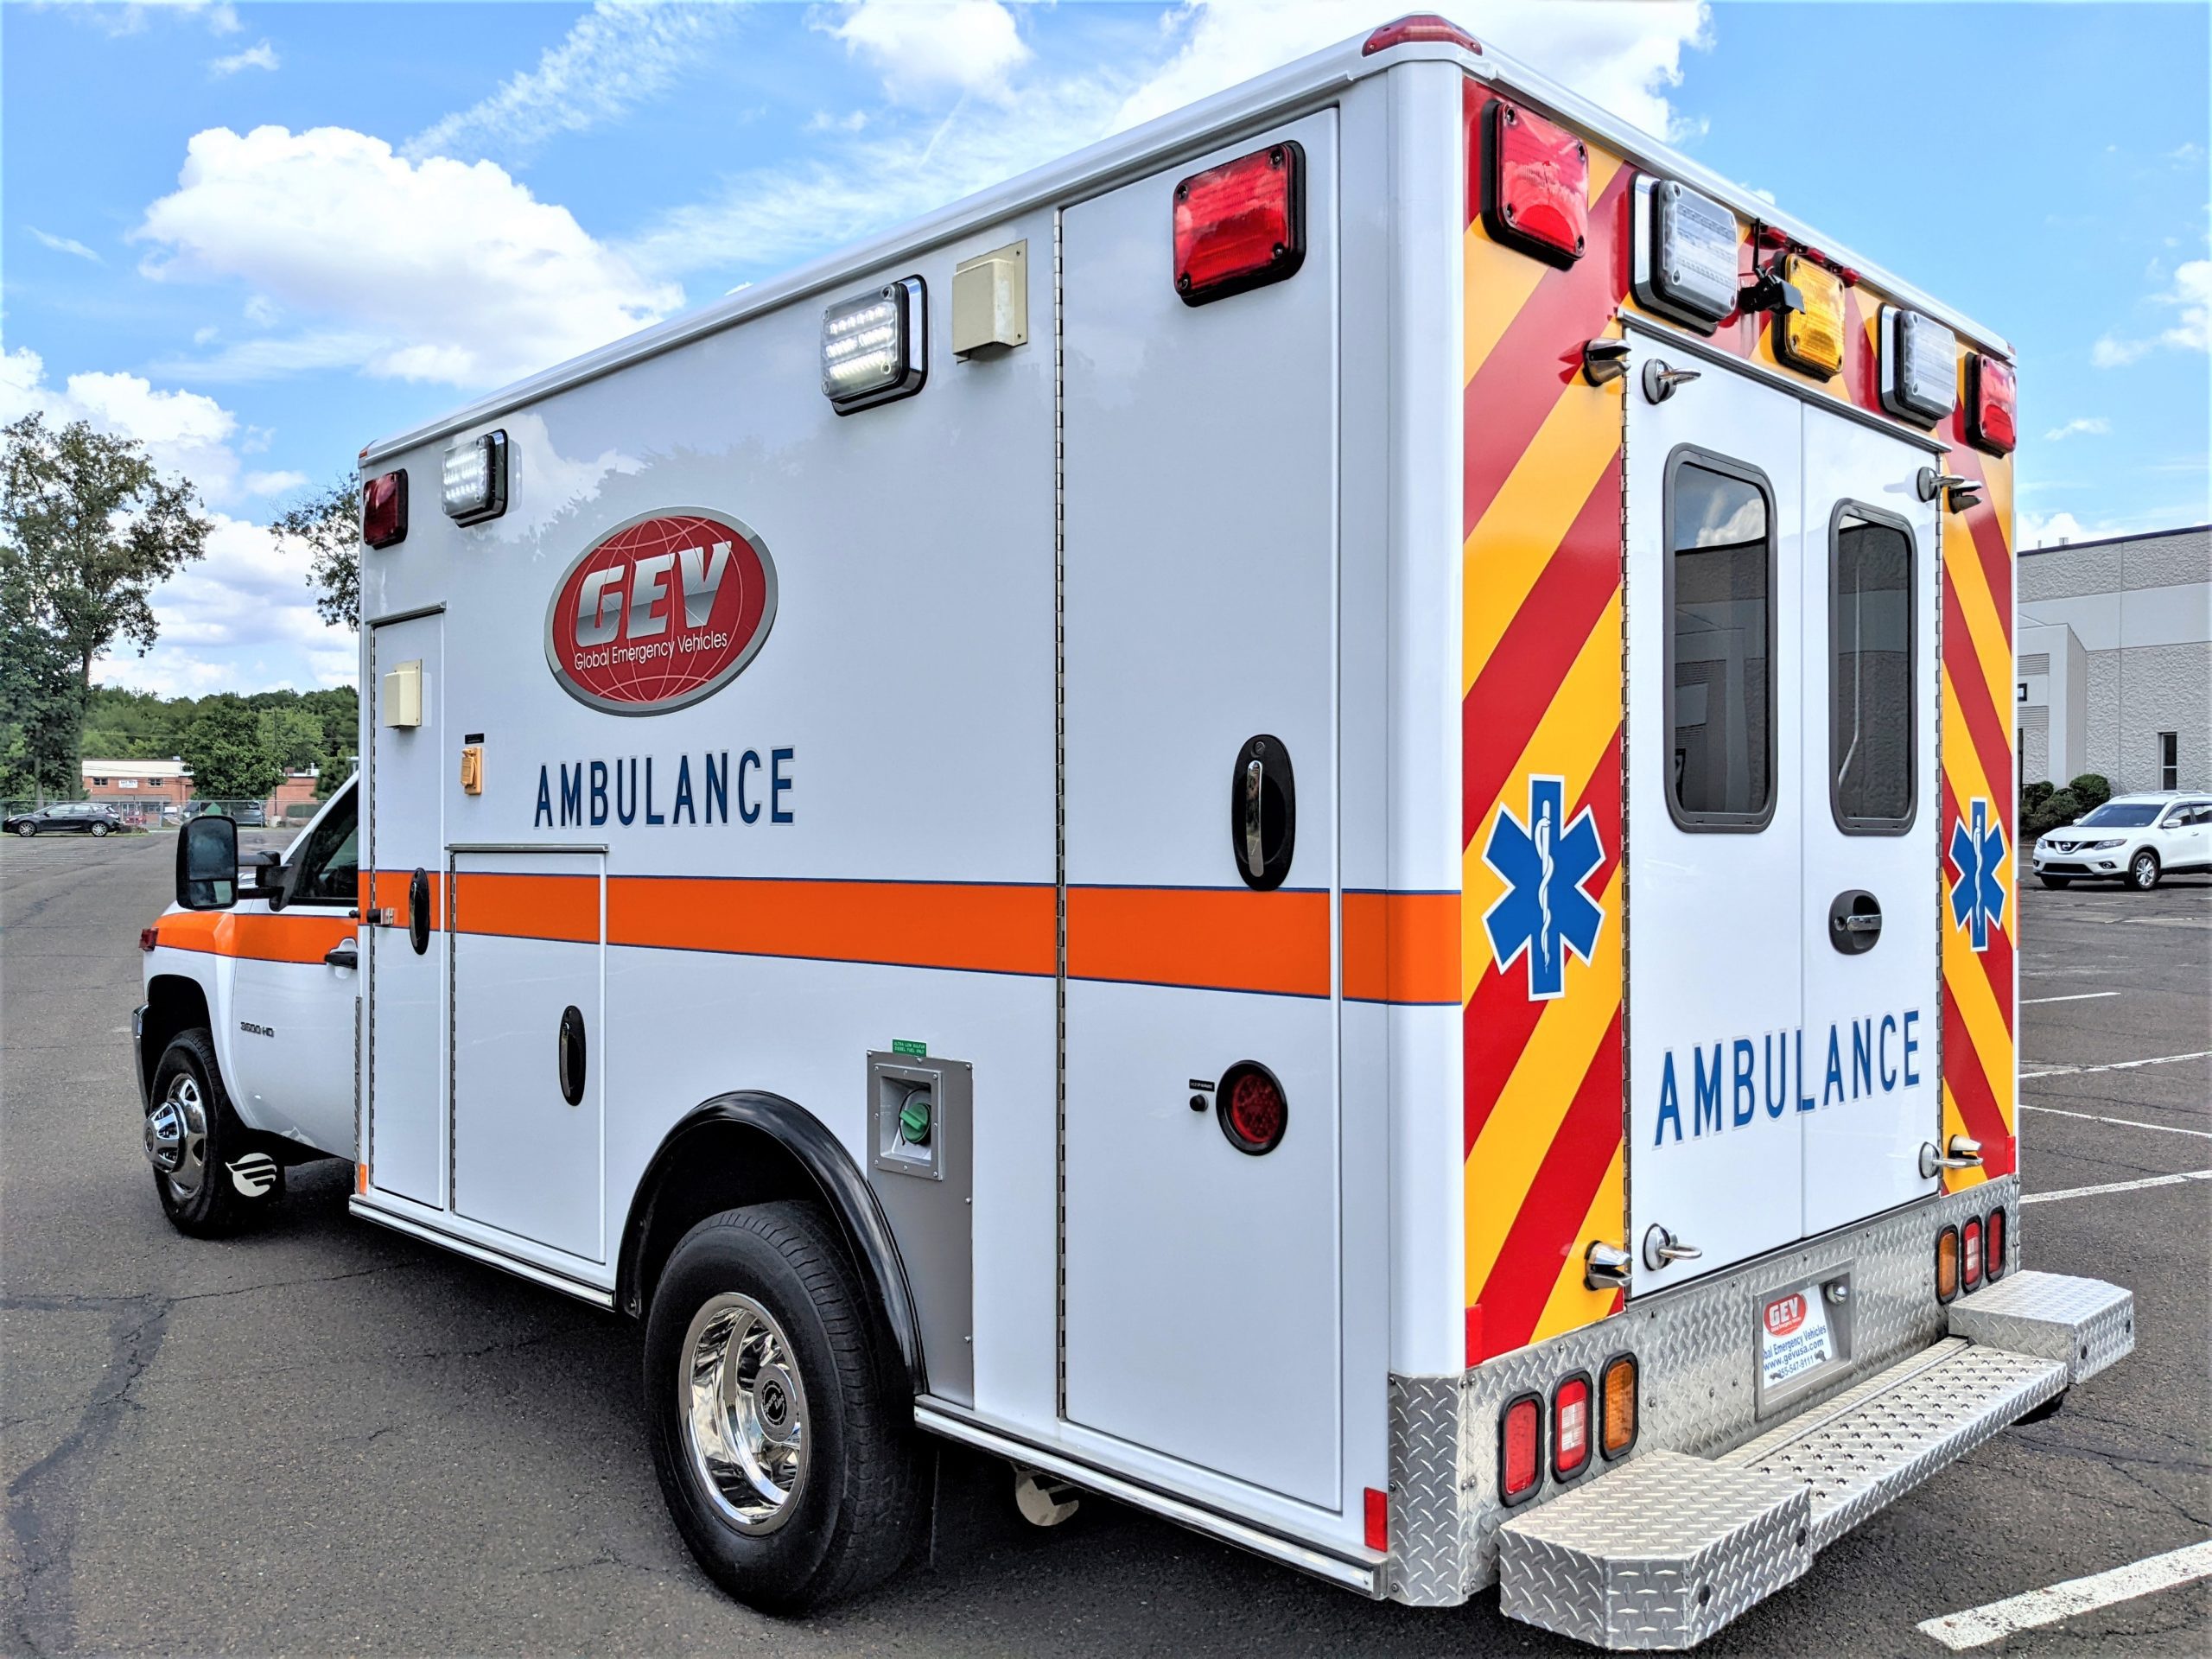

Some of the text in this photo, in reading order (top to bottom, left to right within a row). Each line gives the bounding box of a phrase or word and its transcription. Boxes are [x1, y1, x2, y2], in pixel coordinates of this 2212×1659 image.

[575, 541, 733, 648] GEV
[575, 630, 728, 671] Global Emergency Vehicles
[534, 746, 795, 830] AMBULANCE
[262, 1026, 274, 1038] HD
[1653, 1008, 1920, 1149] AMBULANCE
[1769, 1297, 1798, 1327] GEV
[1763, 1338, 1824, 1372] www.gevusa.com
[1773, 1335, 1803, 1355] Emergency
[1803, 1325, 1827, 1341] Vehicles
